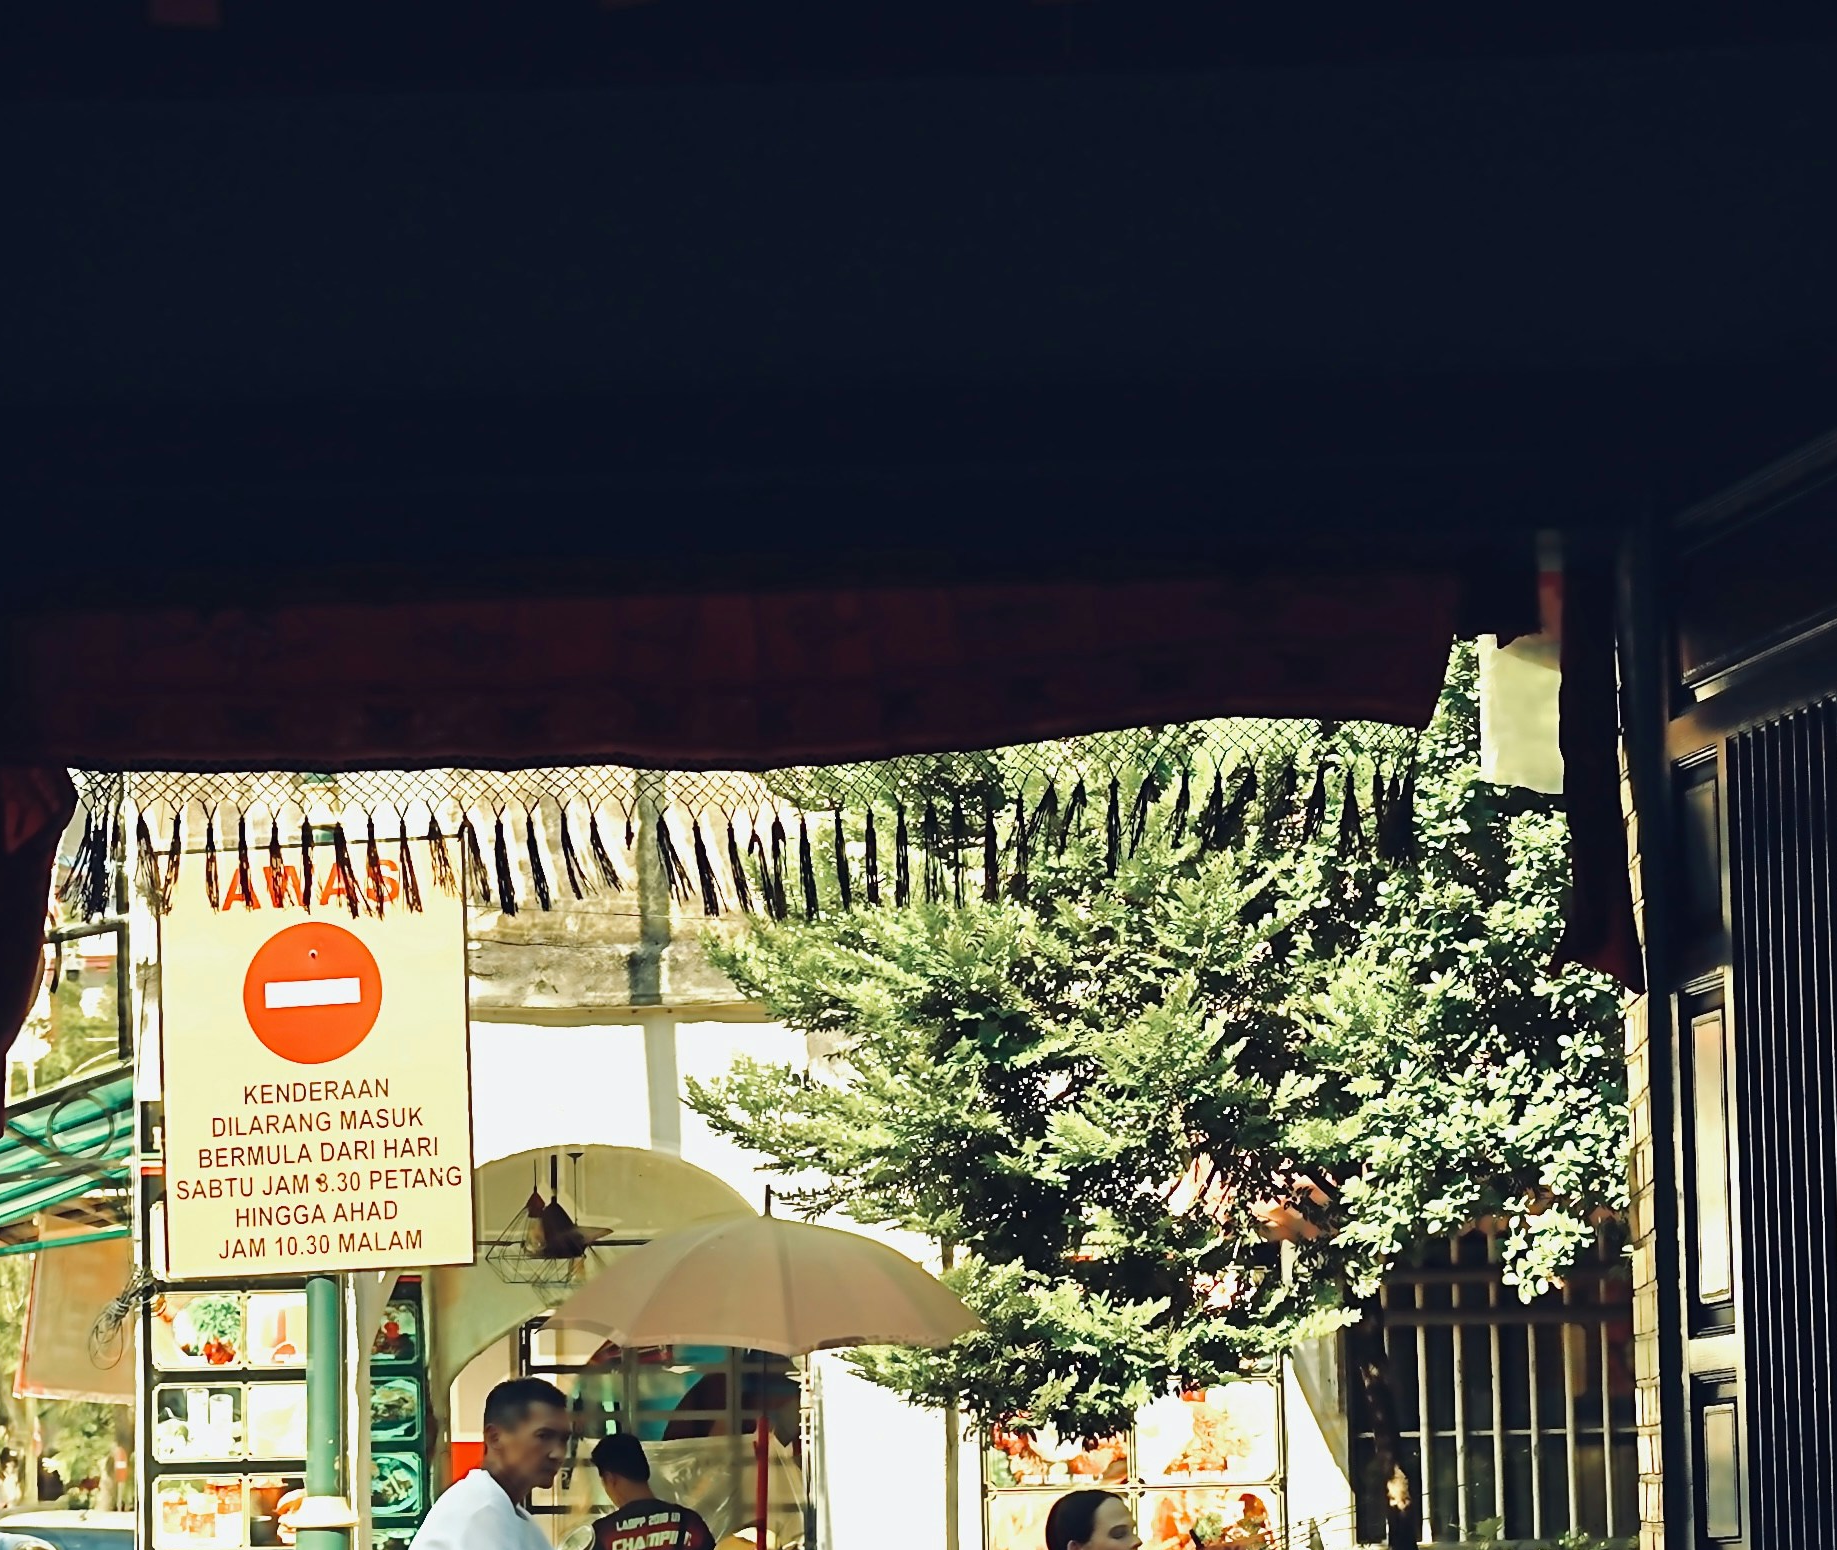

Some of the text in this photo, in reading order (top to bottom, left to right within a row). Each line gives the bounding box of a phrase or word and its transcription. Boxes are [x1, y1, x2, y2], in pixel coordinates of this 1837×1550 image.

[221, 860, 400, 911] AWAS
[245, 1079, 389, 1105] KENDERAAN
[212, 1108, 424, 1138] DILARANG MASUK
[199, 1137, 438, 1169] BERMULA DARI HARI
[177, 1176, 253, 1200] SABTU
[263, 1174, 309, 1197] JAM
[370, 1166, 462, 1190] PETANG
[236, 1201, 398, 1228] HINGGA AHAD
[219, 1230, 422, 1260] JAM 10.30 MALAM
